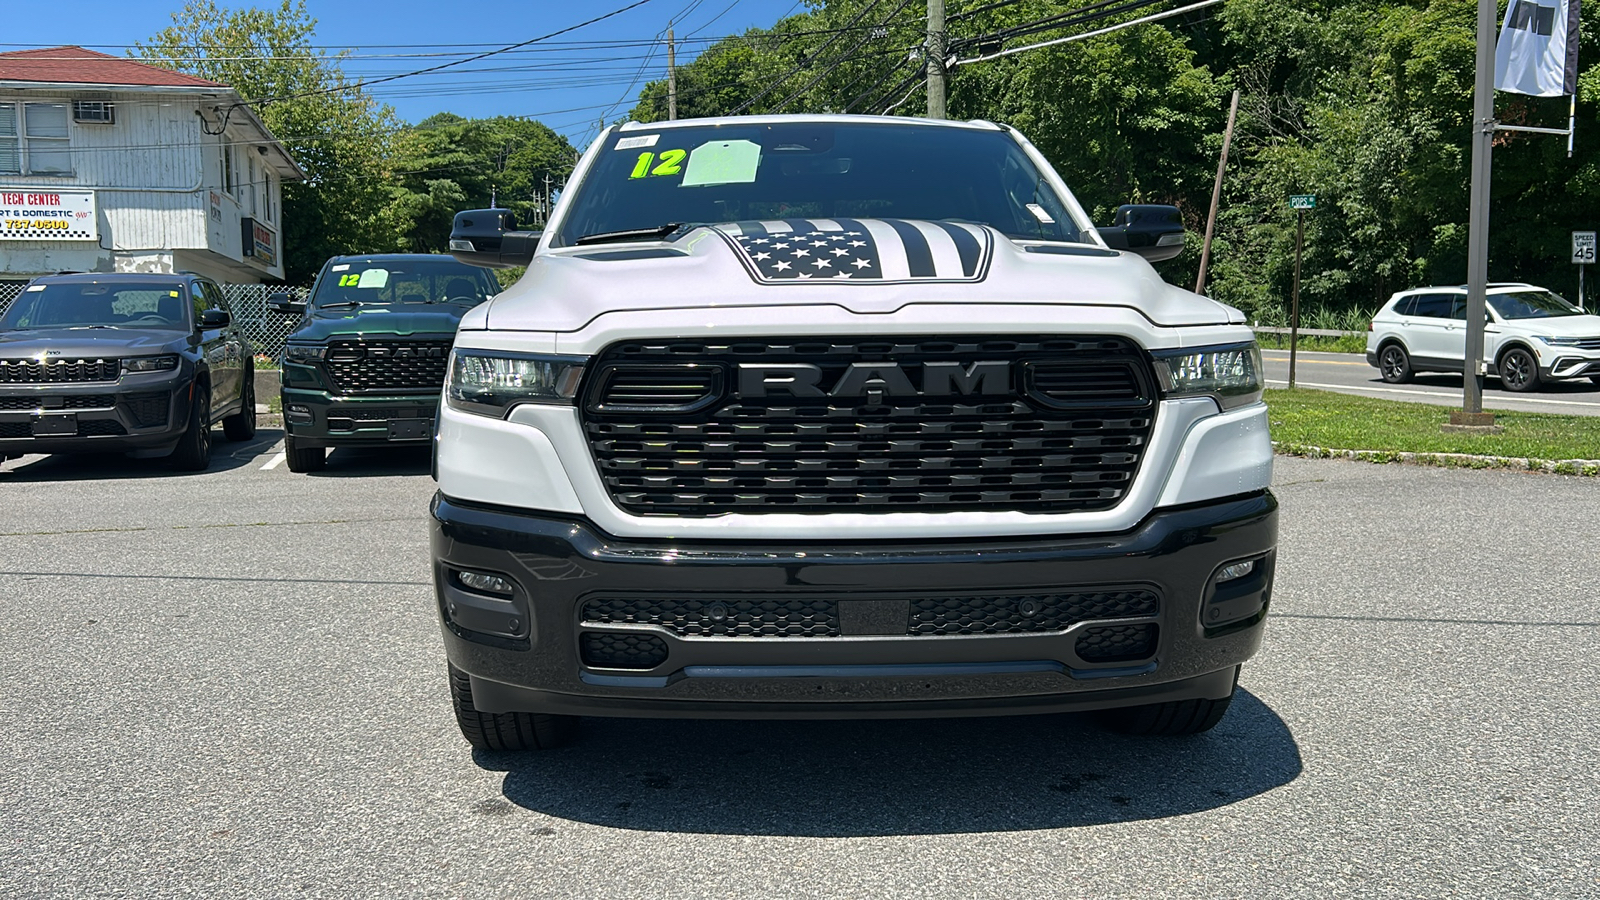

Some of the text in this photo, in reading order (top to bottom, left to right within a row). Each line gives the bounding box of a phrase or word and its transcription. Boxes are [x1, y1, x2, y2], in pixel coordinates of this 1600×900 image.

[629, 148, 687, 179] 12
[2, 193, 61, 206] TECH CENTER
[1291, 197, 1308, 207] POPS
[5, 219, 69, 230] 737-0500
[1574, 248, 1594, 259] 45
[338, 273, 361, 287] 12
[367, 347, 441, 358] RAM
[738, 361, 1011, 398] RAM
